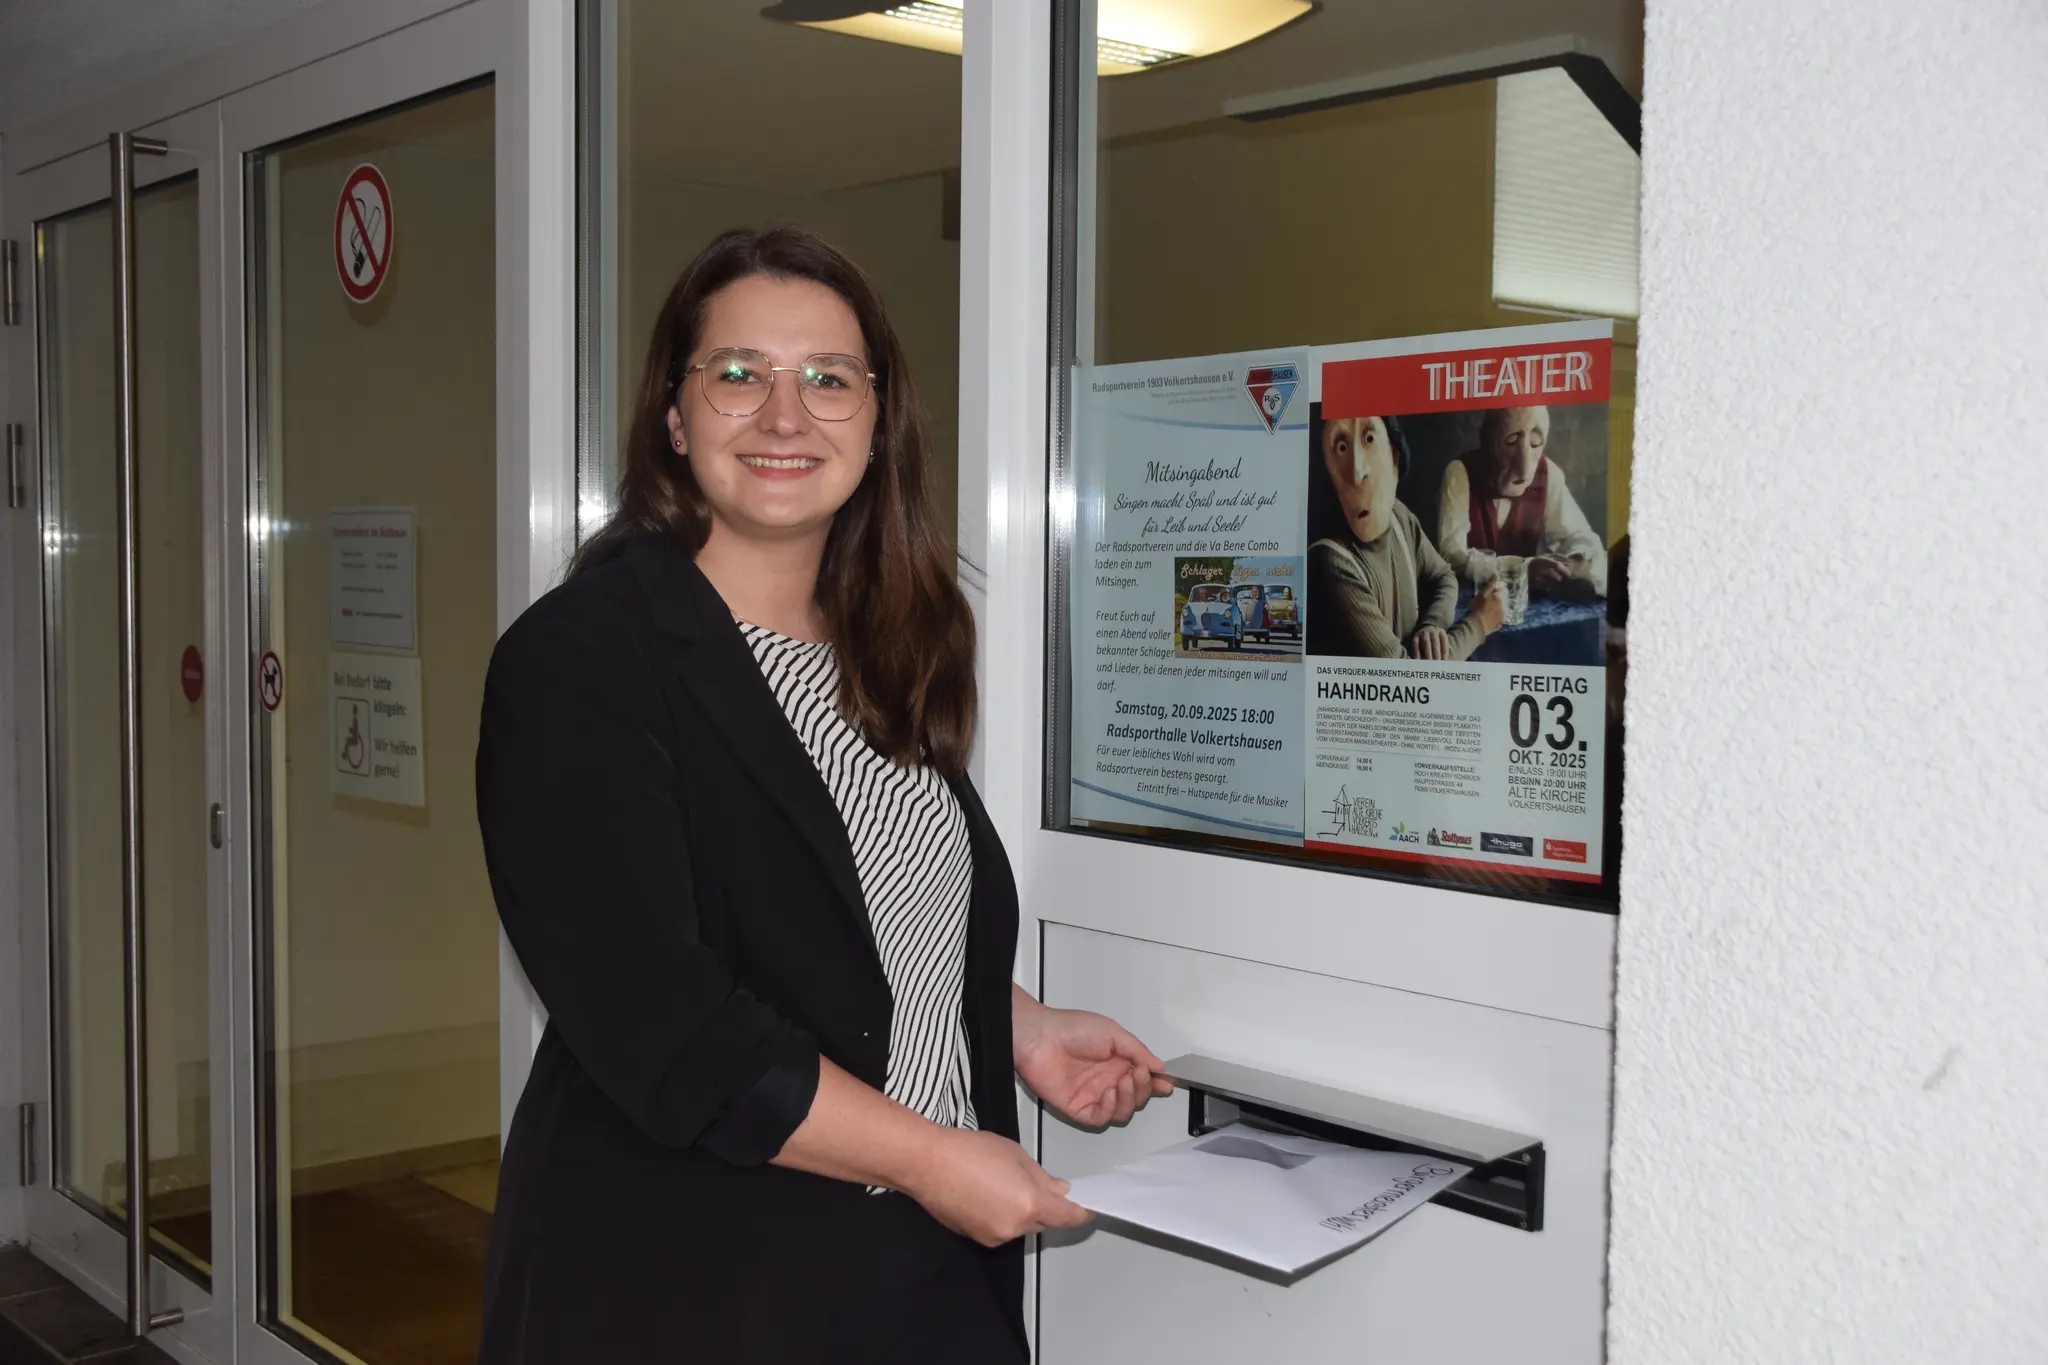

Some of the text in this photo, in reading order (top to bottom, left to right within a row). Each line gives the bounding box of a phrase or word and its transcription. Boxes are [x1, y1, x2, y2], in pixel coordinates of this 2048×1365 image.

[1092, 378, 1146, 393] Radsportverein
[1147, 378, 1163, 388] 1903
[1164, 373, 1221, 388] Volkertshausen
[1222, 371, 1235, 382] e.V.
[1421, 351, 1592, 401] THEATER
[1145, 457, 1242, 487] Mitsingabend
[1114, 488, 1278, 514] Singen macht Spaß und ist gut
[1141, 514, 1248, 538] für Leib und Seele!
[1095, 539, 1279, 554] Der Radsportverein und die Va Bene Combo
[1094, 558, 1152, 570] laden ein zum
[1180, 564, 1223, 580] Schlager
[1095, 576, 1139, 588] Mitsingen.
[1096, 610, 1156, 624] Freut Euch auf
[1096, 628, 1171, 641] einen Abend voller
[1096, 644, 1175, 659] bekannter Schlager
[1097, 662, 1288, 682] und Lieder, bei denen jeder mitsingen will und
[1316, 666, 1482, 681] DAS VERQUER-MASKENTHEATER PRÄSENTIERT
[1096, 680, 1116, 693] darf.
[1317, 681, 1430, 704] HAHNDRANG
[1509, 674, 1588, 695] FREITAG
[1115, 700, 1275, 725] Samstag, 20.09.2025 18:00
[1509, 693, 1588, 752] 03.
[1106, 723, 1283, 751] Radsporthalle Volkertshausen
[1096, 744, 1235, 767] Für euer leibliches Wohl wird vom
[1509, 749, 1587, 769] OKT. 2025
[1096, 762, 1229, 785] Radsportverein bestens gesorgt.
[1508, 765, 1587, 780] EINLASS 19:00 UHR
[1508, 776, 1587, 791] BEGINN 20:00 UHR
[1137, 782, 1165, 795] Eintritt
[1165, 783, 1180, 797] frei
[1187, 786, 1228, 804] Hutspende
[1229, 790, 1241, 804] für
[1242, 792, 1255, 805] die
[1256, 794, 1289, 808] Musiker
[1508, 786, 1587, 804] ALTE KIRCHE
[1508, 799, 1587, 814] VOLKERTSHAUSEN
[1398, 834, 1420, 844] AACH
